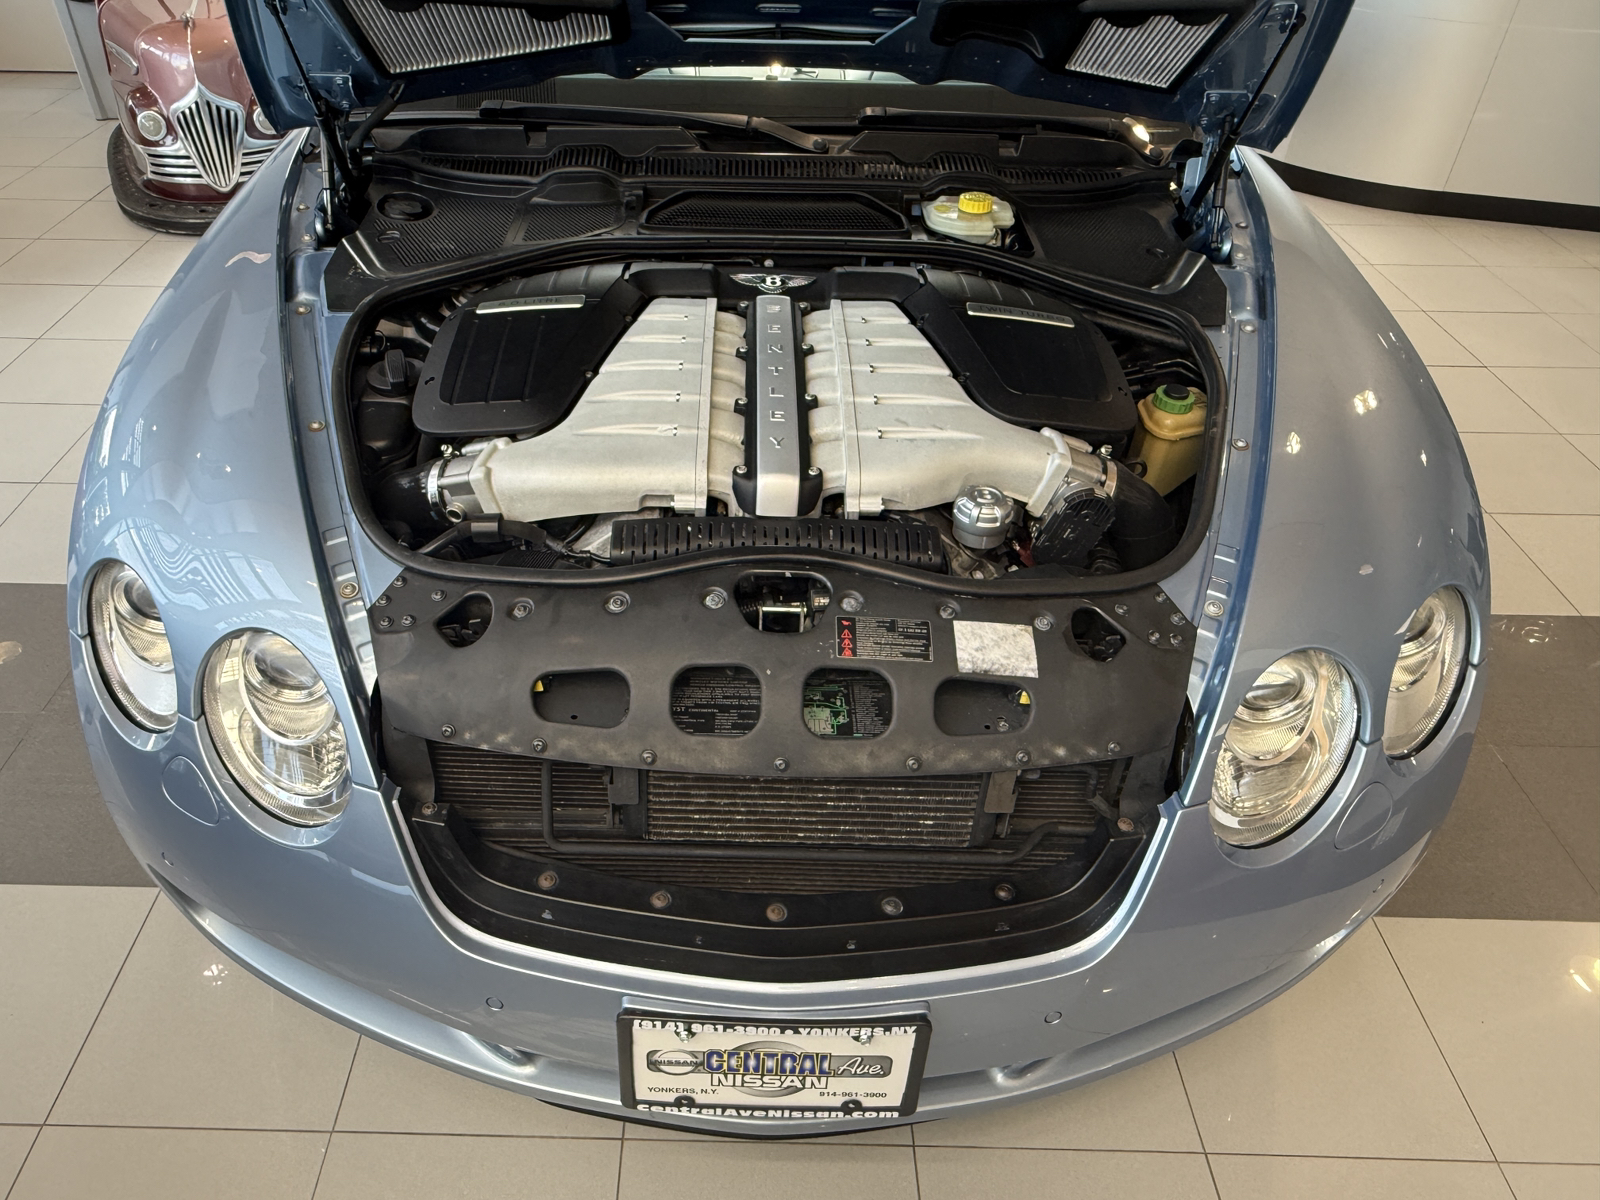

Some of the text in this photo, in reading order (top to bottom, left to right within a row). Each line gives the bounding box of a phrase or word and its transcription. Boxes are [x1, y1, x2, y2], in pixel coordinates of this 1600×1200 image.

[978, 304, 1065, 322] TWIN TURBO
[766, 304, 786, 449] BENTLEY
[703, 1049, 886, 1077] CENTRAL Ave.
[711, 1073, 829, 1090] NISSAN
[647, 1086, 719, 1096] YONKERS, N.Y.
[819, 1091, 888, 1099] 914-961-3900
